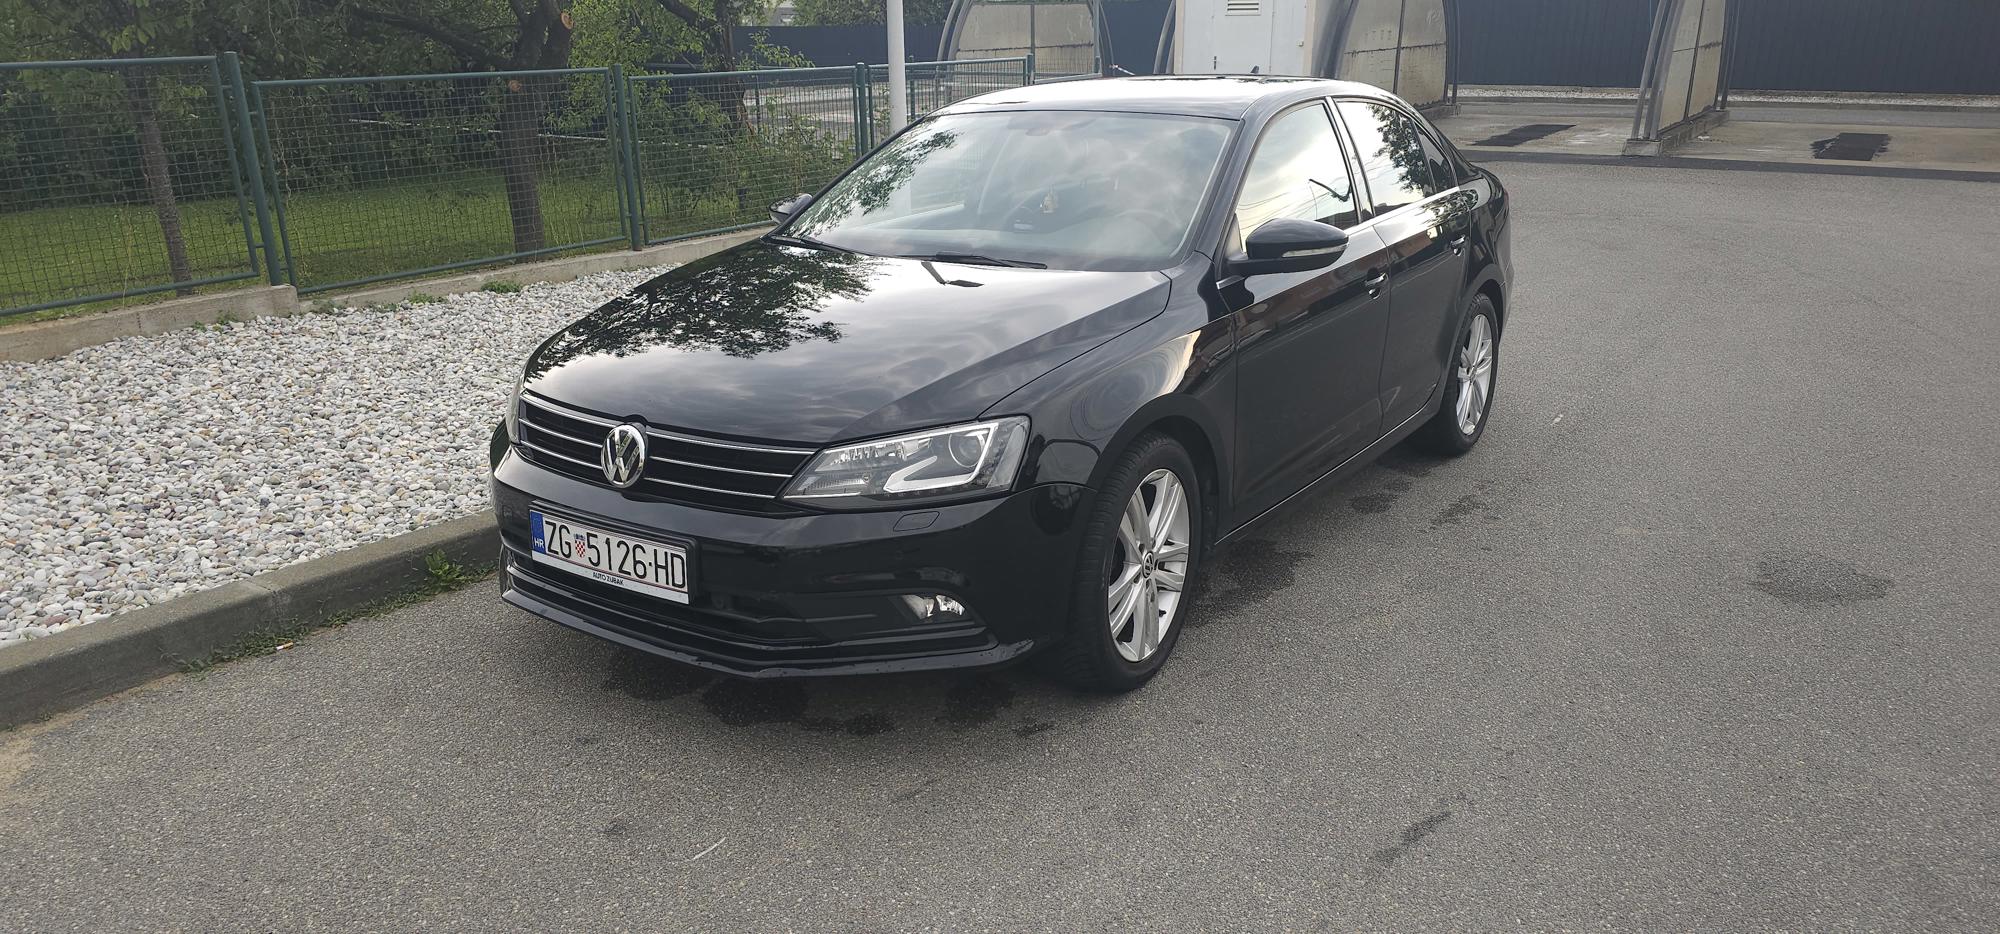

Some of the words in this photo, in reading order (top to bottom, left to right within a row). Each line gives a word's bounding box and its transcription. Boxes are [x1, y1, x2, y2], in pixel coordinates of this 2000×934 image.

[534, 537, 544, 549] HR
[545, 520, 571, 558] ZG
[593, 571, 606, 581] AUTO
